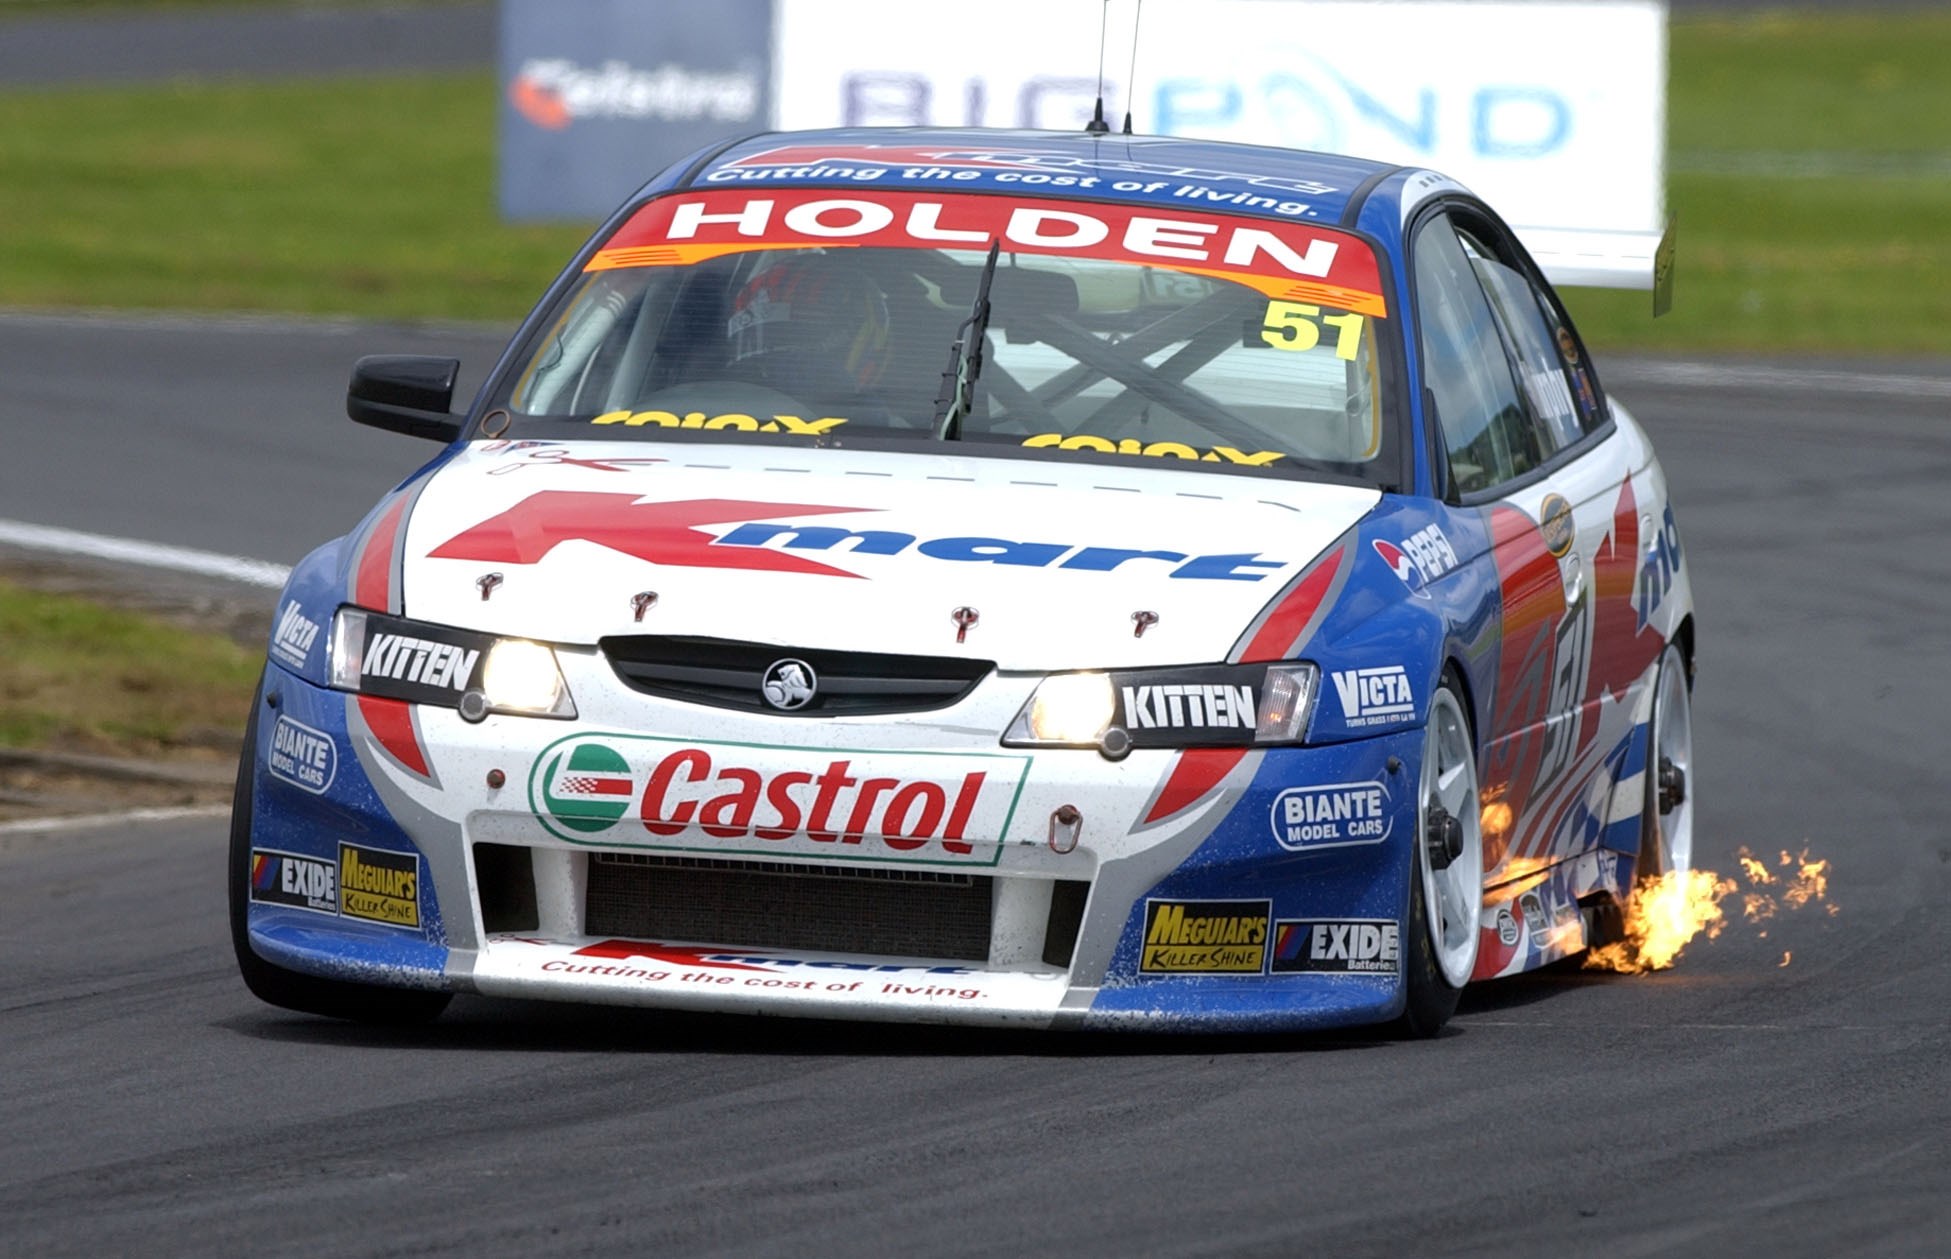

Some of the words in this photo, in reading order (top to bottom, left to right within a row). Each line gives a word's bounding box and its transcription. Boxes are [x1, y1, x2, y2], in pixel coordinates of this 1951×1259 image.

[707, 165, 888, 181] Cutting
[901, 167, 981, 180] the
[995, 172, 1102, 188] cost
[1112, 180, 1169, 193] of
[1173, 185, 1318, 217] living.
[666, 199, 1339, 278] HOLDEN
[1261, 300, 1364, 361] 51
[425, 489, 1289, 581] Kmart
[1401, 523, 1459, 582] PEPSI
[274, 599, 320, 652] VICTA
[361, 633, 480, 691] KITTEN
[1122, 684, 1257, 730] KITTEN
[1331, 669, 1413, 718] VICTA
[272, 751, 295, 775] MODEL
[298, 764, 324, 786] CARS
[275, 722, 329, 769] BIANTE
[640, 749, 987, 854] Castrol
[1284, 790, 1383, 824] BIANTE
[1287, 824, 1340, 842] MODEL
[1347, 819, 1384, 836] CARS
[282, 858, 336, 900] EXIDE
[340, 848, 415, 899] MEGUIAR'S
[1147, 905, 1268, 945] MEGUIAR'S
[1310, 924, 1399, 960] EXIDE
[541, 960, 671, 982] Cutting
[680, 972, 735, 985] the
[743, 976, 818, 990] cost
[825, 980, 864, 992] of
[881, 982, 988, 1000] living.
[570, 939, 978, 974] Kmart
